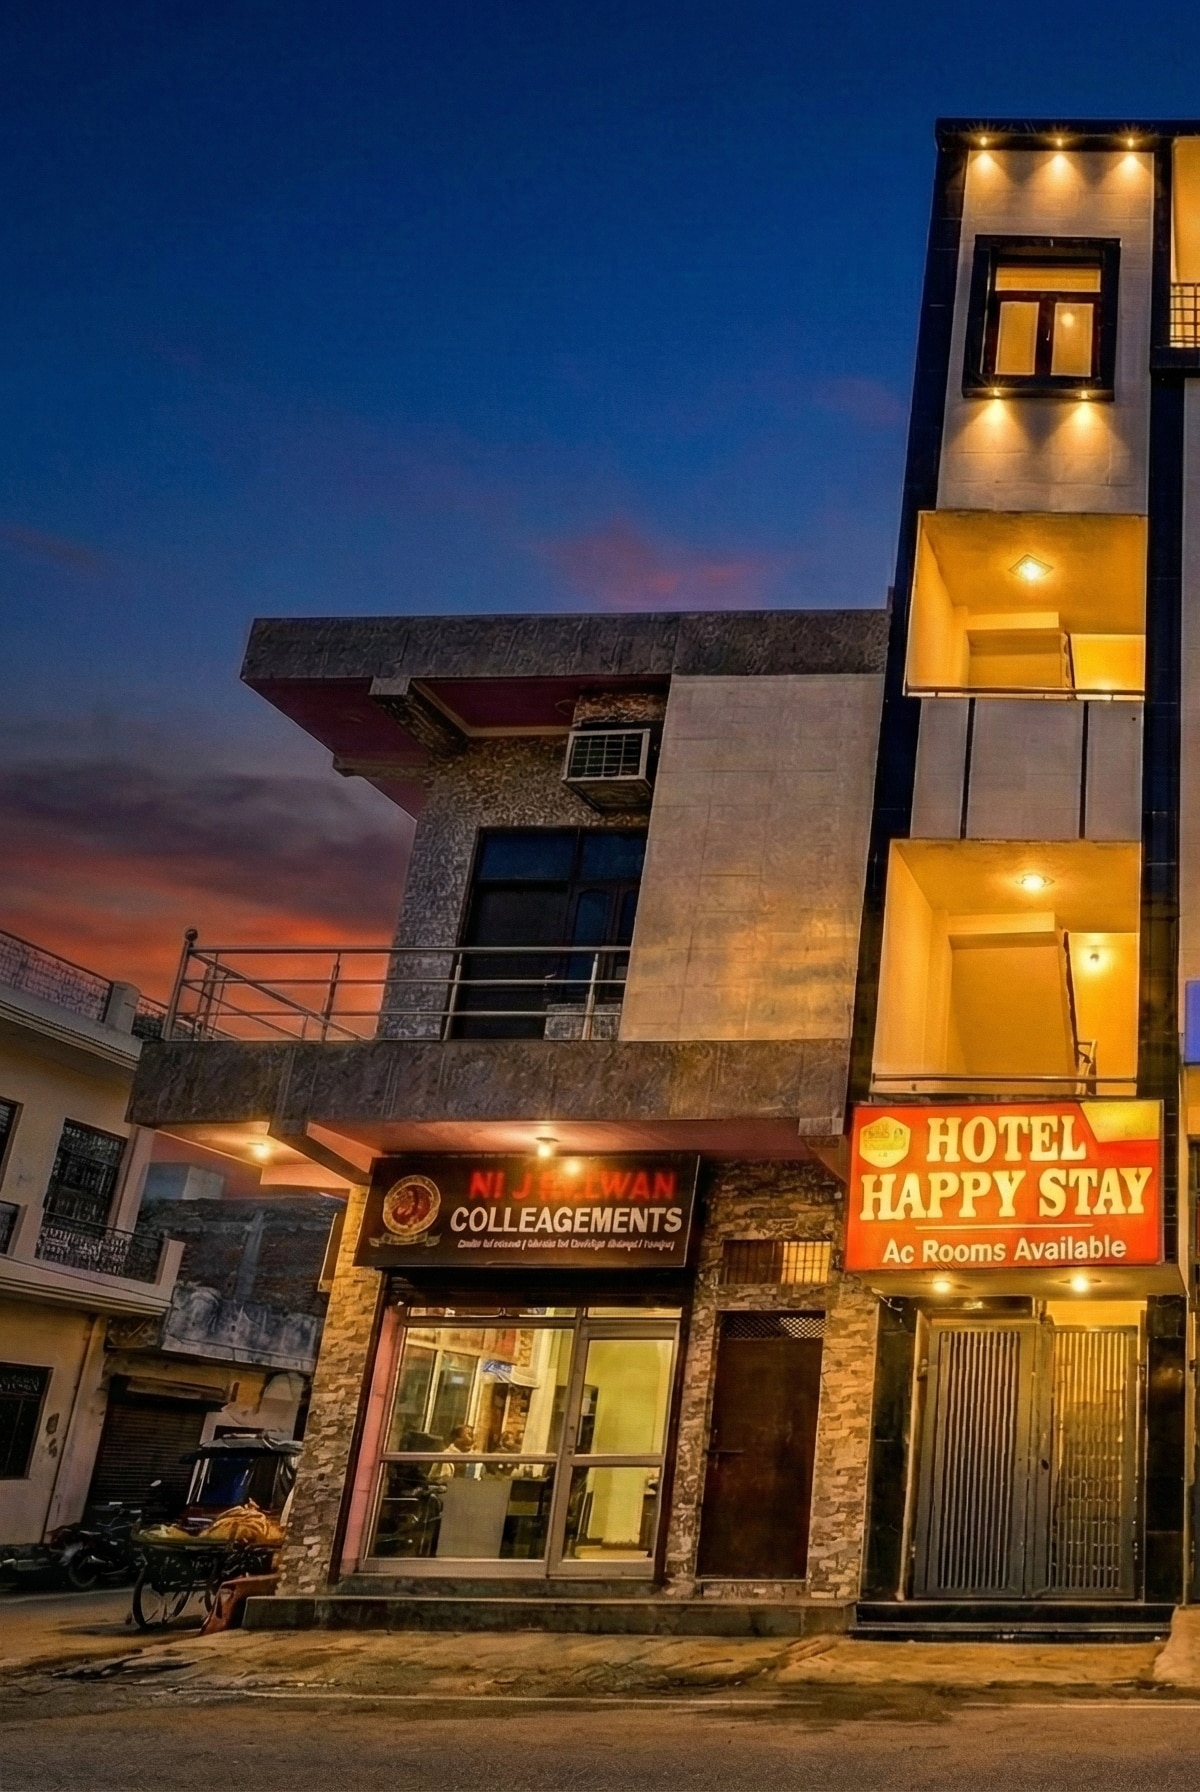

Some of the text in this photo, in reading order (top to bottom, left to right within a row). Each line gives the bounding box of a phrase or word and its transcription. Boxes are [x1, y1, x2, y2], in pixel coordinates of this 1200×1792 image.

[926, 1115, 1087, 1163] HOTEL
[859, 1167, 1153, 1220] HAPPY STAY
[450, 1206, 683, 1234] COLLEAGEMENTS
[882, 1234, 1127, 1264] Ac Rooms Available
